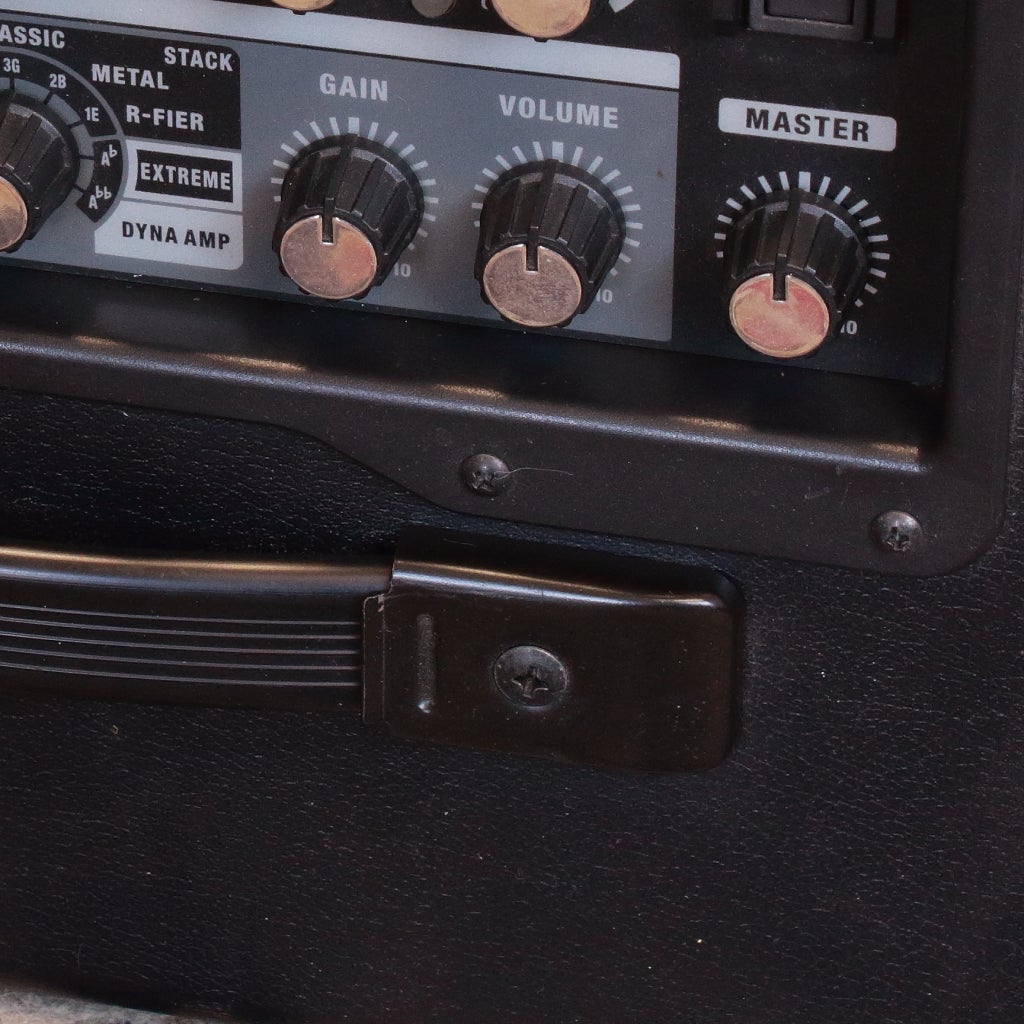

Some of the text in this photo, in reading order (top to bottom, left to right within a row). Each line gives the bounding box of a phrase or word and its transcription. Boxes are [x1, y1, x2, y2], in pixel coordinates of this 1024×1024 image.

[3, 58, 21, 73] 3G
[164, 46, 233, 71] STACK
[49, 74, 66, 89] 2B
[92, 64, 170, 90] METAL
[319, 73, 388, 102] GAIN
[84, 107, 99, 122] 1E
[126, 105, 204, 131] R-FIER
[498, 94, 619, 129] VOLUME
[745, 108, 870, 142] MASTER
[140, 163, 231, 190] EXTREME
[122, 221, 230, 250] DYNA AMP
